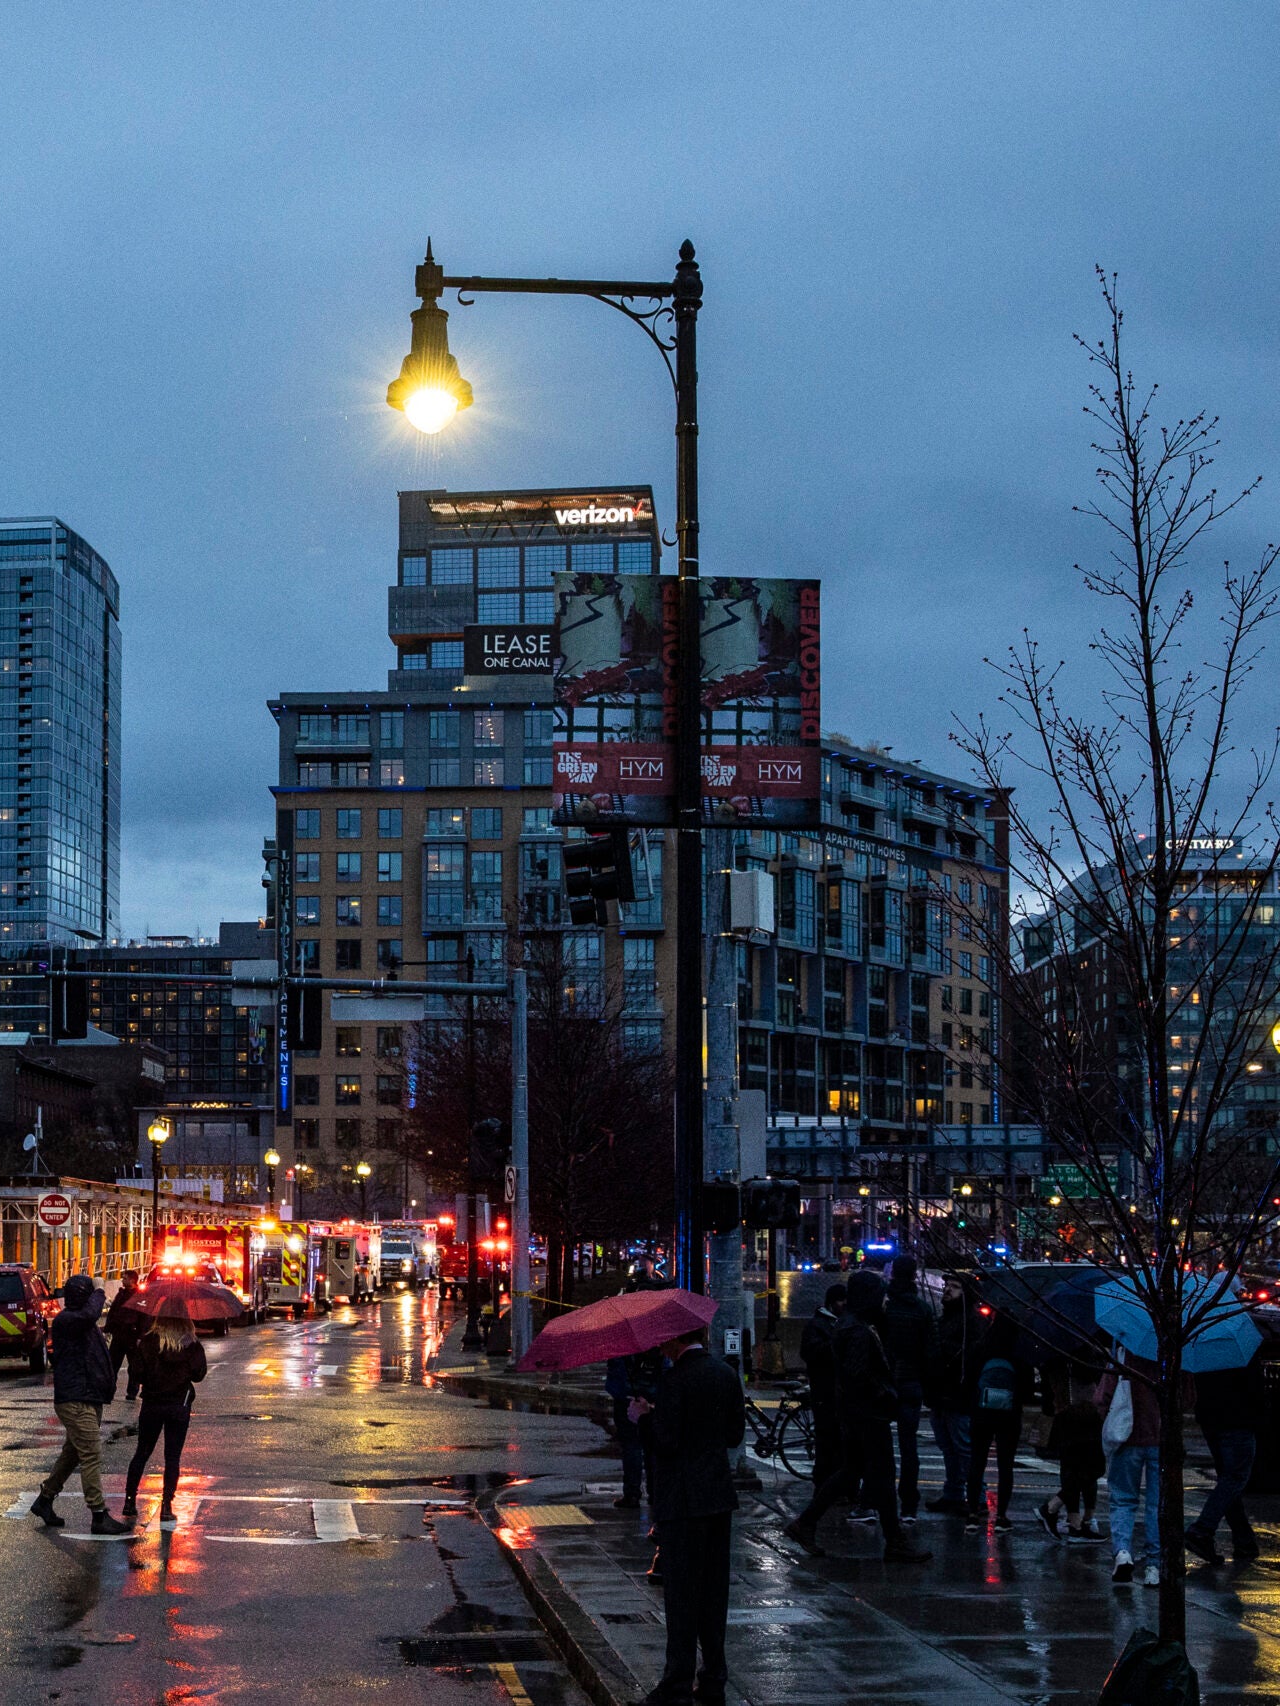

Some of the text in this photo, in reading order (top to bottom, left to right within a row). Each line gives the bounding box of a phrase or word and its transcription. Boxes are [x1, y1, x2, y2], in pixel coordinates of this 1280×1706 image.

[555, 505, 634, 524] verizon
[483, 634, 551, 654] LEASE
[484, 657, 551, 668] ONE CANAL
[800, 587, 820, 740] DISCOVER
[557, 752, 582, 763] THE
[557, 762, 598, 773] GREEN
[621, 761, 663, 776] HYM
[758, 765, 802, 779] HYM
[569, 773, 595, 784] WAY
[708, 775, 734, 787] WAY
[825, 832, 877, 853] APARTMENT
[877, 845, 906, 862] HOMES
[1165, 839, 1235, 850] CTYARD
[279, 967, 289, 1086] ARTMENTS
